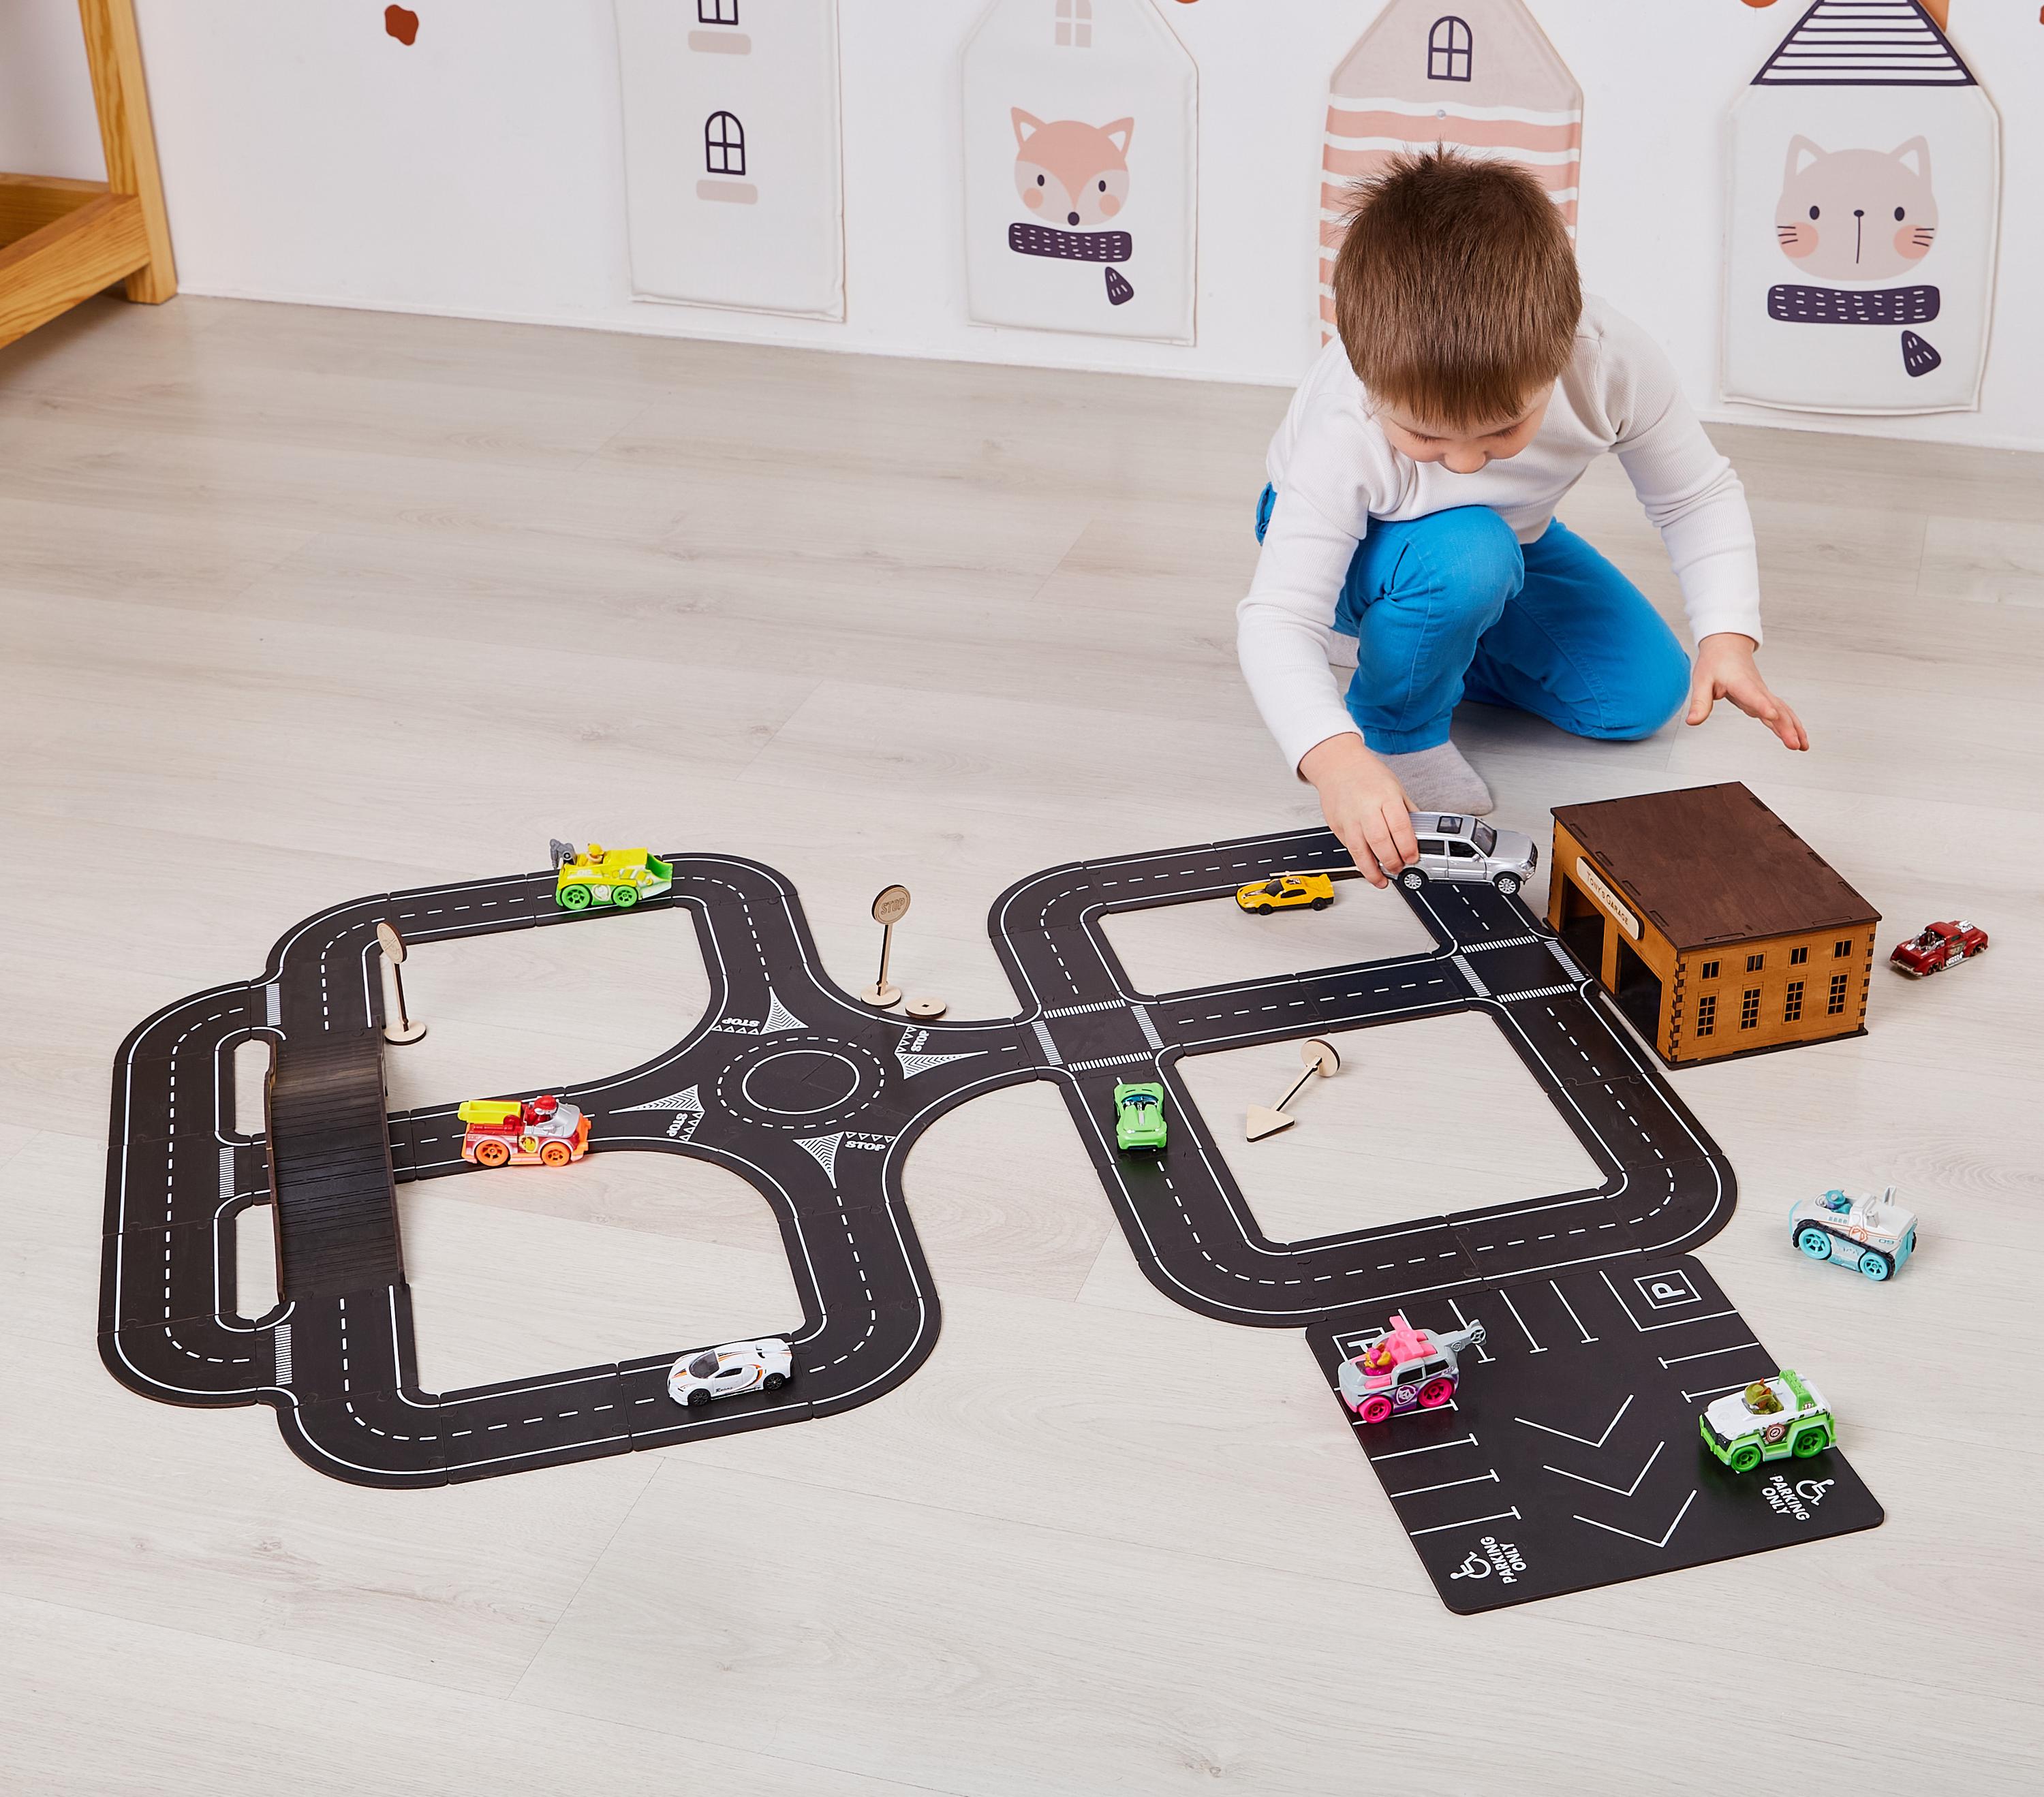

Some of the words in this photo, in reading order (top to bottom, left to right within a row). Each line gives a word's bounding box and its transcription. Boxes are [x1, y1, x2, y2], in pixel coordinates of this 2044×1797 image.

[881, 897, 905, 915] STOP
[721, 1017, 760, 1027] STOP
[910, 1030, 929, 1052] STOP
[666, 1112, 688, 1137] STOP
[845, 1140, 886, 1152] STOP
[1651, 1283, 1686, 1300] P
[1761, 1487, 1791, 1514] ONLY
[1769, 1475, 1811, 1520] PARKING
[1481, 1536, 1518, 1584] PARKING
[1499, 1543, 1527, 1572] ONLY
